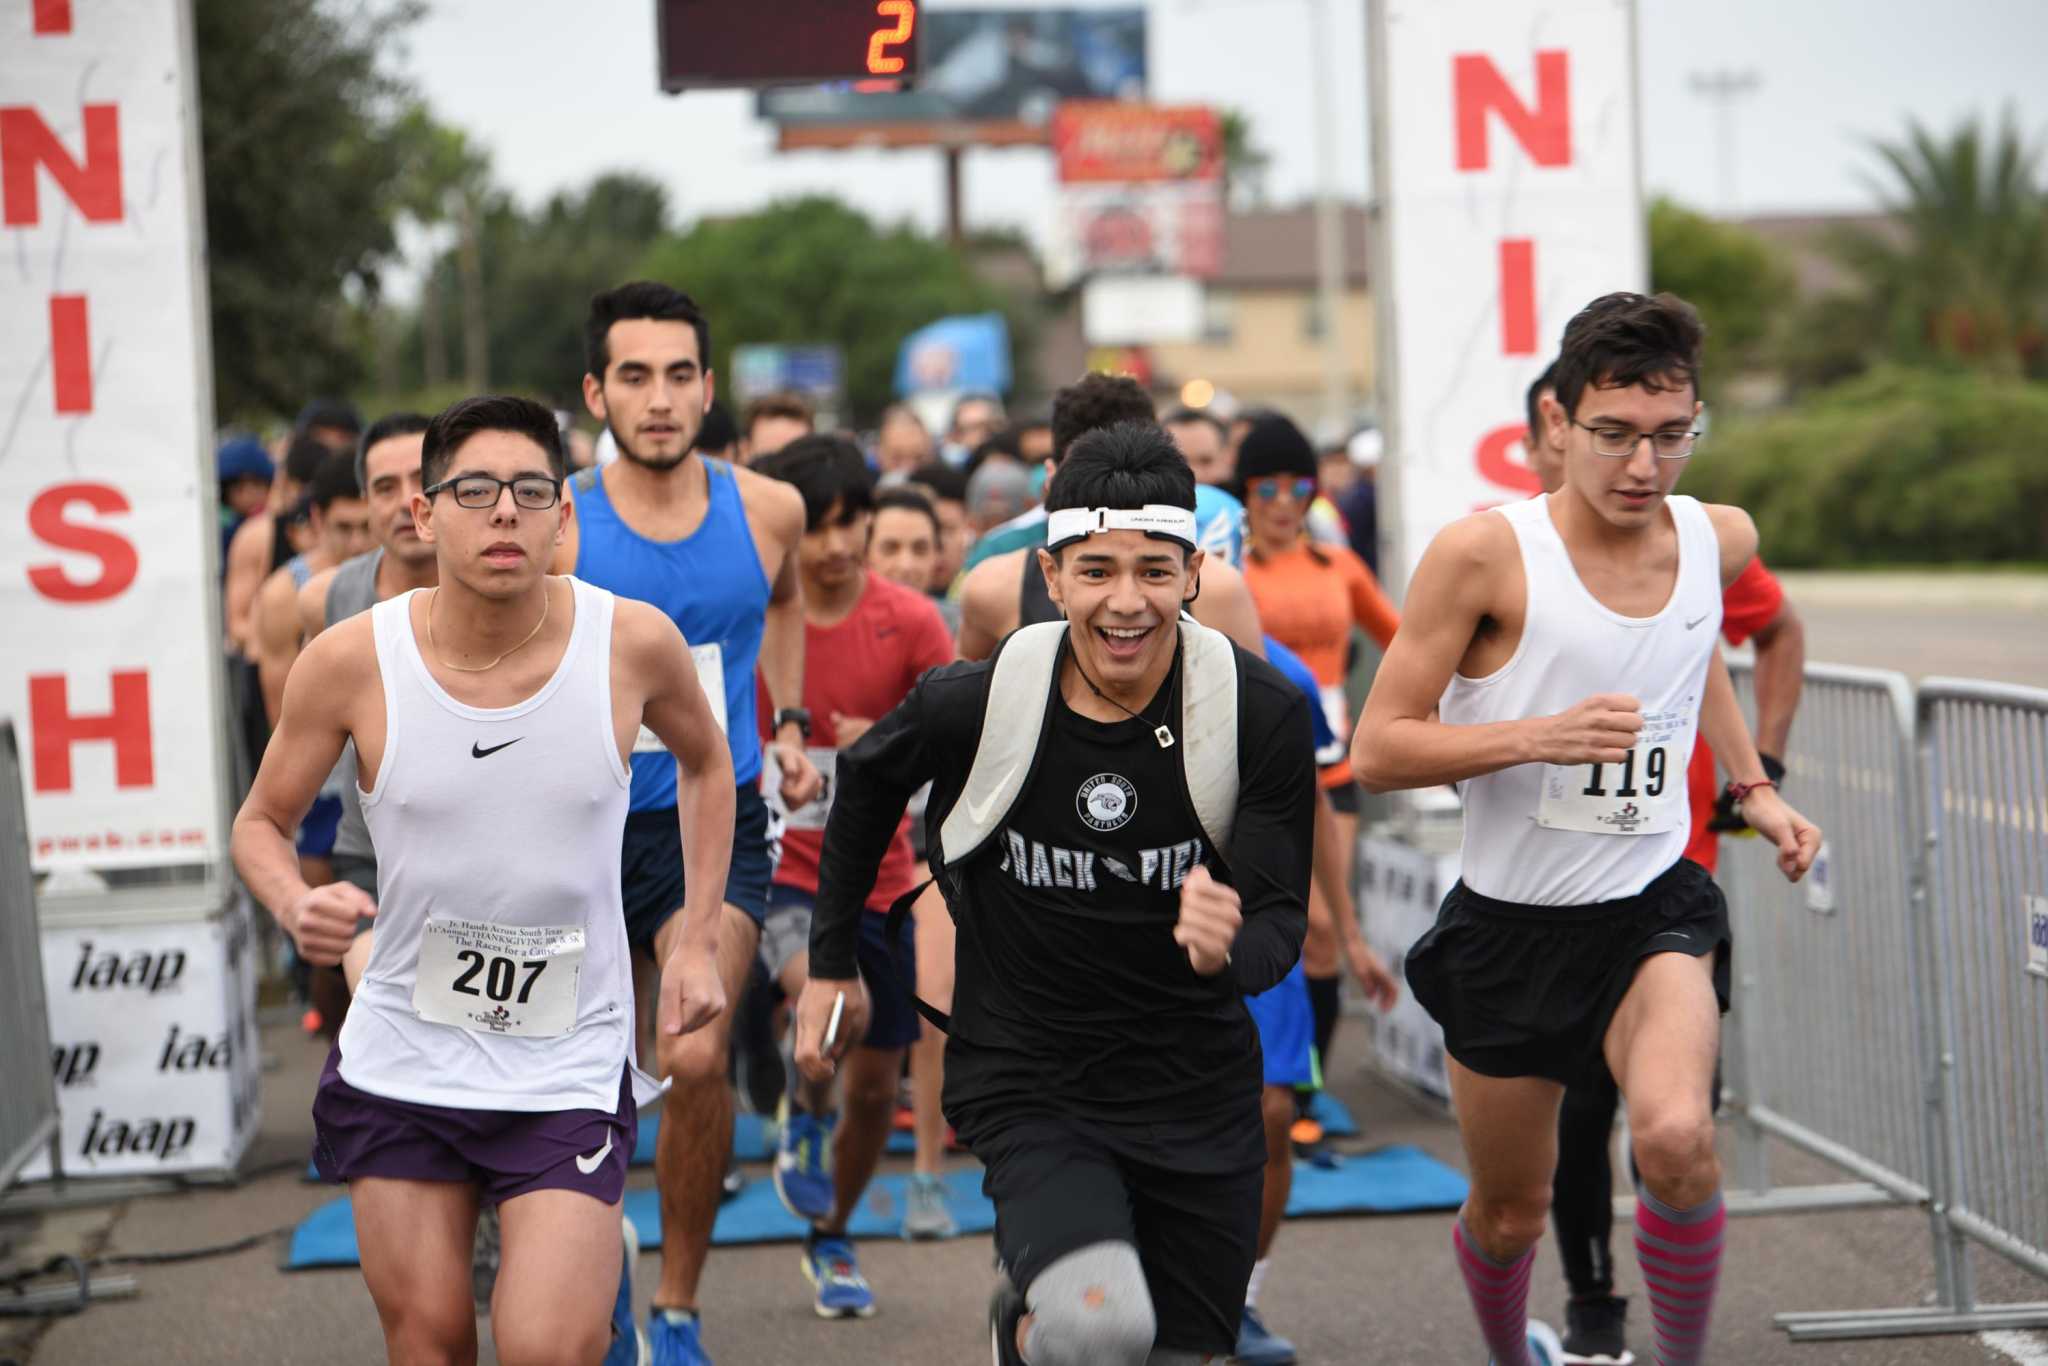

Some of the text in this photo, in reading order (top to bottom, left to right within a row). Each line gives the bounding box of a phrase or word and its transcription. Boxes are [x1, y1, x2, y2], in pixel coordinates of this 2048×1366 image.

[867, 0, 915, 74] 2
[1080, 776, 1134, 798] UNITED SOUTH
[1582, 747, 1666, 797] 119
[1083, 812, 1129, 829] PANTHERS
[472, 930, 543, 946] THANKSGIVING
[504, 944, 518, 956] for
[71, 941, 186, 996] iaap
[452, 950, 547, 1004] 207
[82, 1108, 196, 1160] iaap
